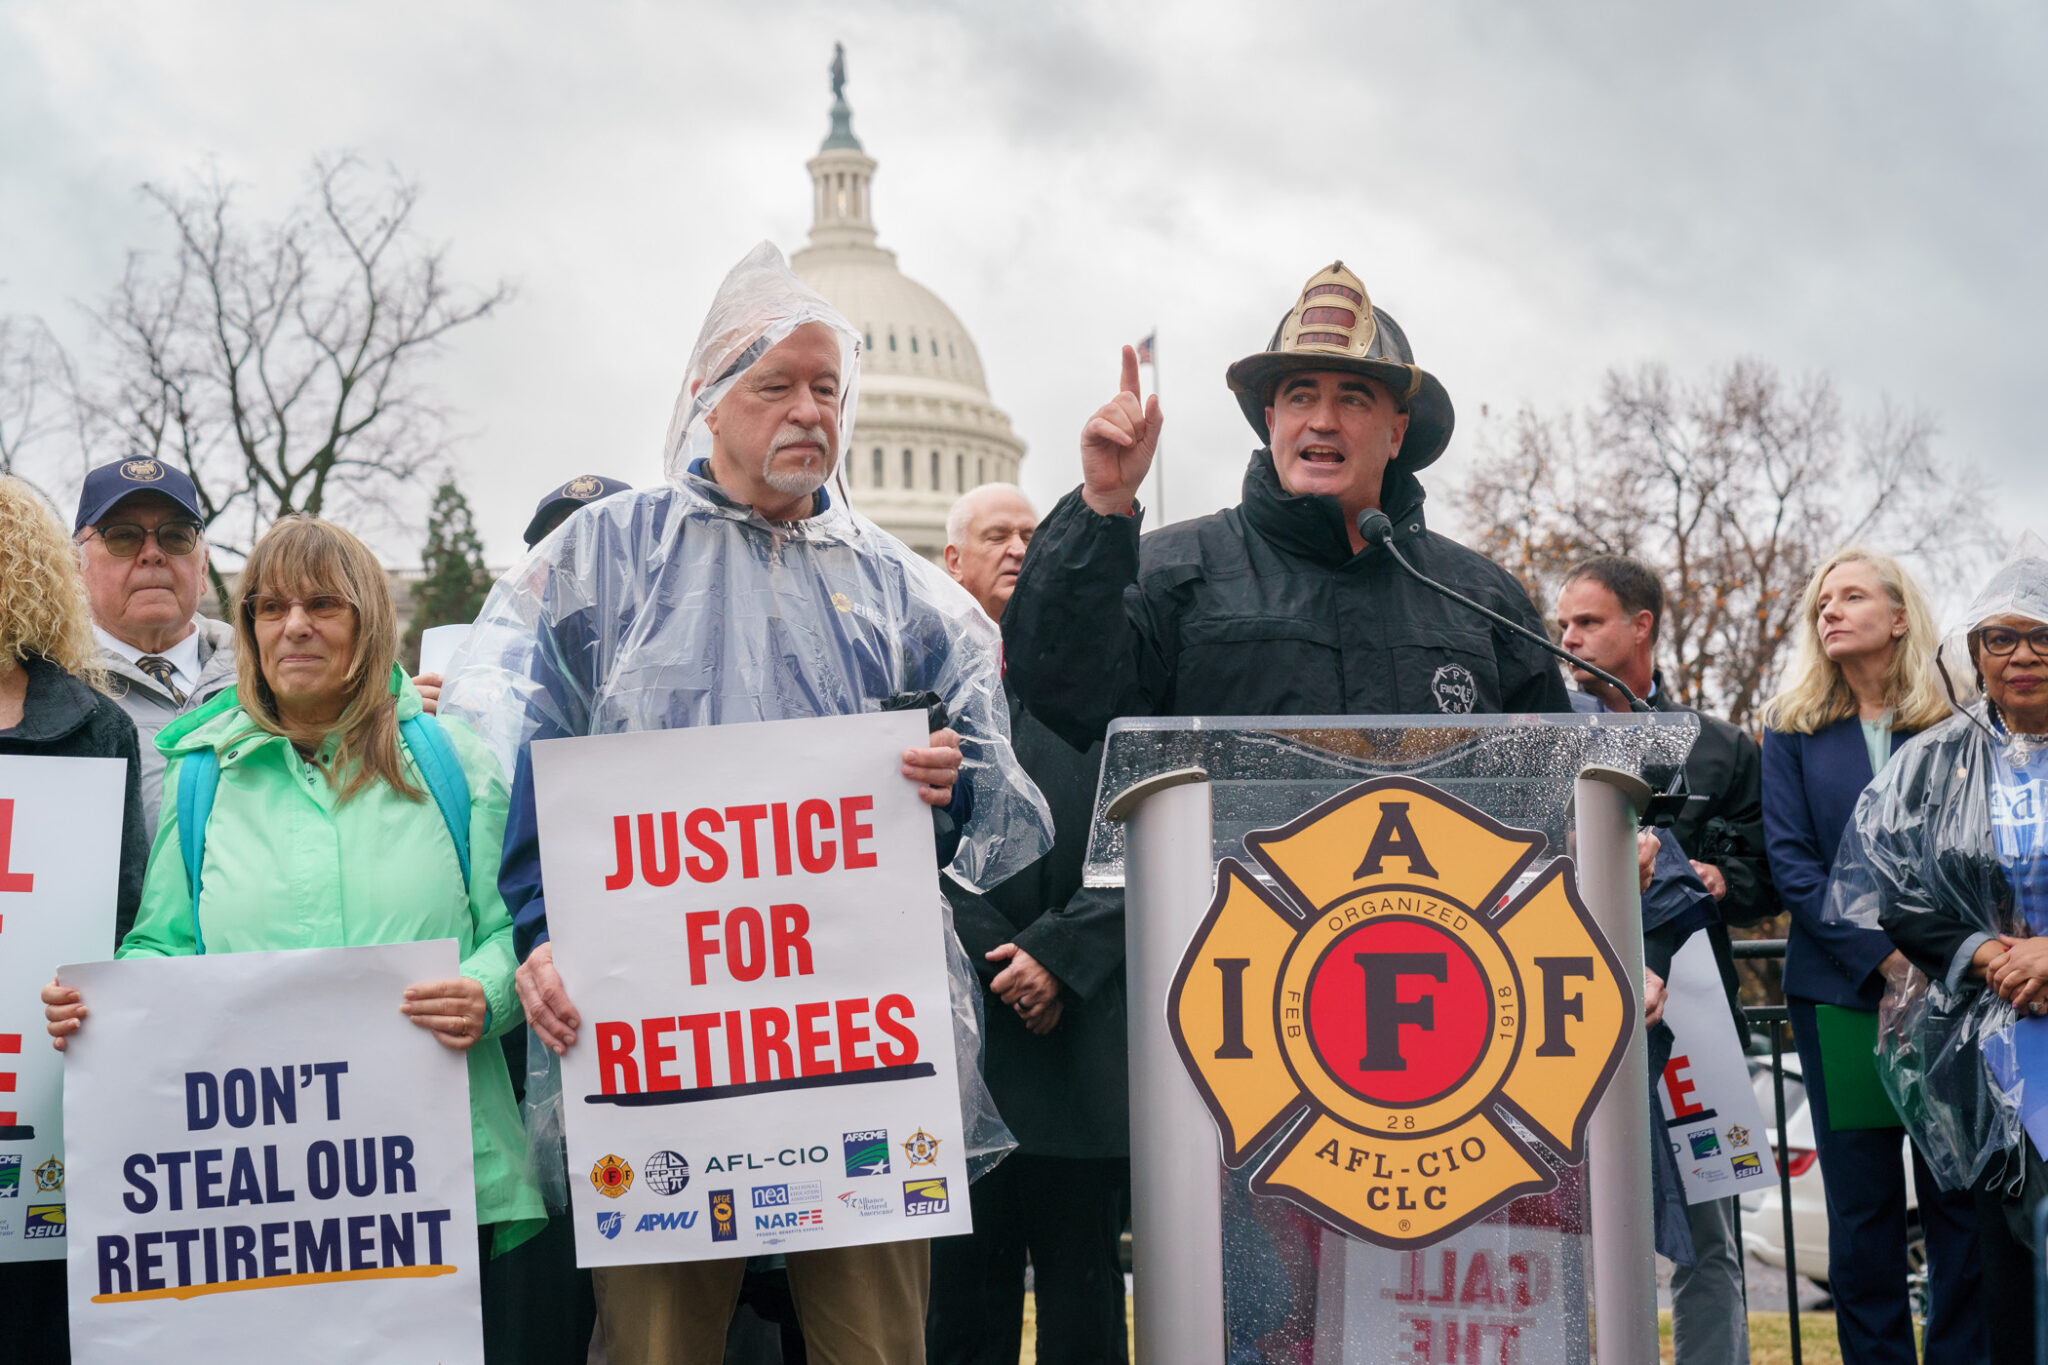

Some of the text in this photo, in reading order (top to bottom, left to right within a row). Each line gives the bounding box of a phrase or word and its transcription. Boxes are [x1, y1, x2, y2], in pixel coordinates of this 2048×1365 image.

[604, 794, 878, 891] JUSTICE
[1328, 896, 1469, 933] ORGANIZED
[685, 903, 815, 987] FOR
[1284, 990, 1301, 1039] FEB
[1497, 985, 1514, 1041] 1918
[595, 993, 920, 1096] RETIREES
[185, 1061, 349, 1131] DON'T
[1386, 1115, 1416, 1130] 28
[844, 1130, 886, 1143] AFSCME
[704, 1146, 829, 1174] AFL-CIO
[1314, 1135, 1487, 1180] AFL-CIO
[122, 1135, 417, 1214] STEAL OUR
[645, 1167, 690, 1179] IFPTE
[1736, 1165, 1761, 1178] SEIU
[713, 1195, 732, 1204] AFGE
[754, 1187, 788, 1206] nea
[906, 1200, 948, 1216] SEIU
[1366, 1186, 1448, 1211] CLC
[25, 1224, 65, 1238] SEIU
[635, 1210, 699, 1232] APWU
[755, 1209, 824, 1230] NARFE
[96, 1209, 452, 1296] RETIREMENT
